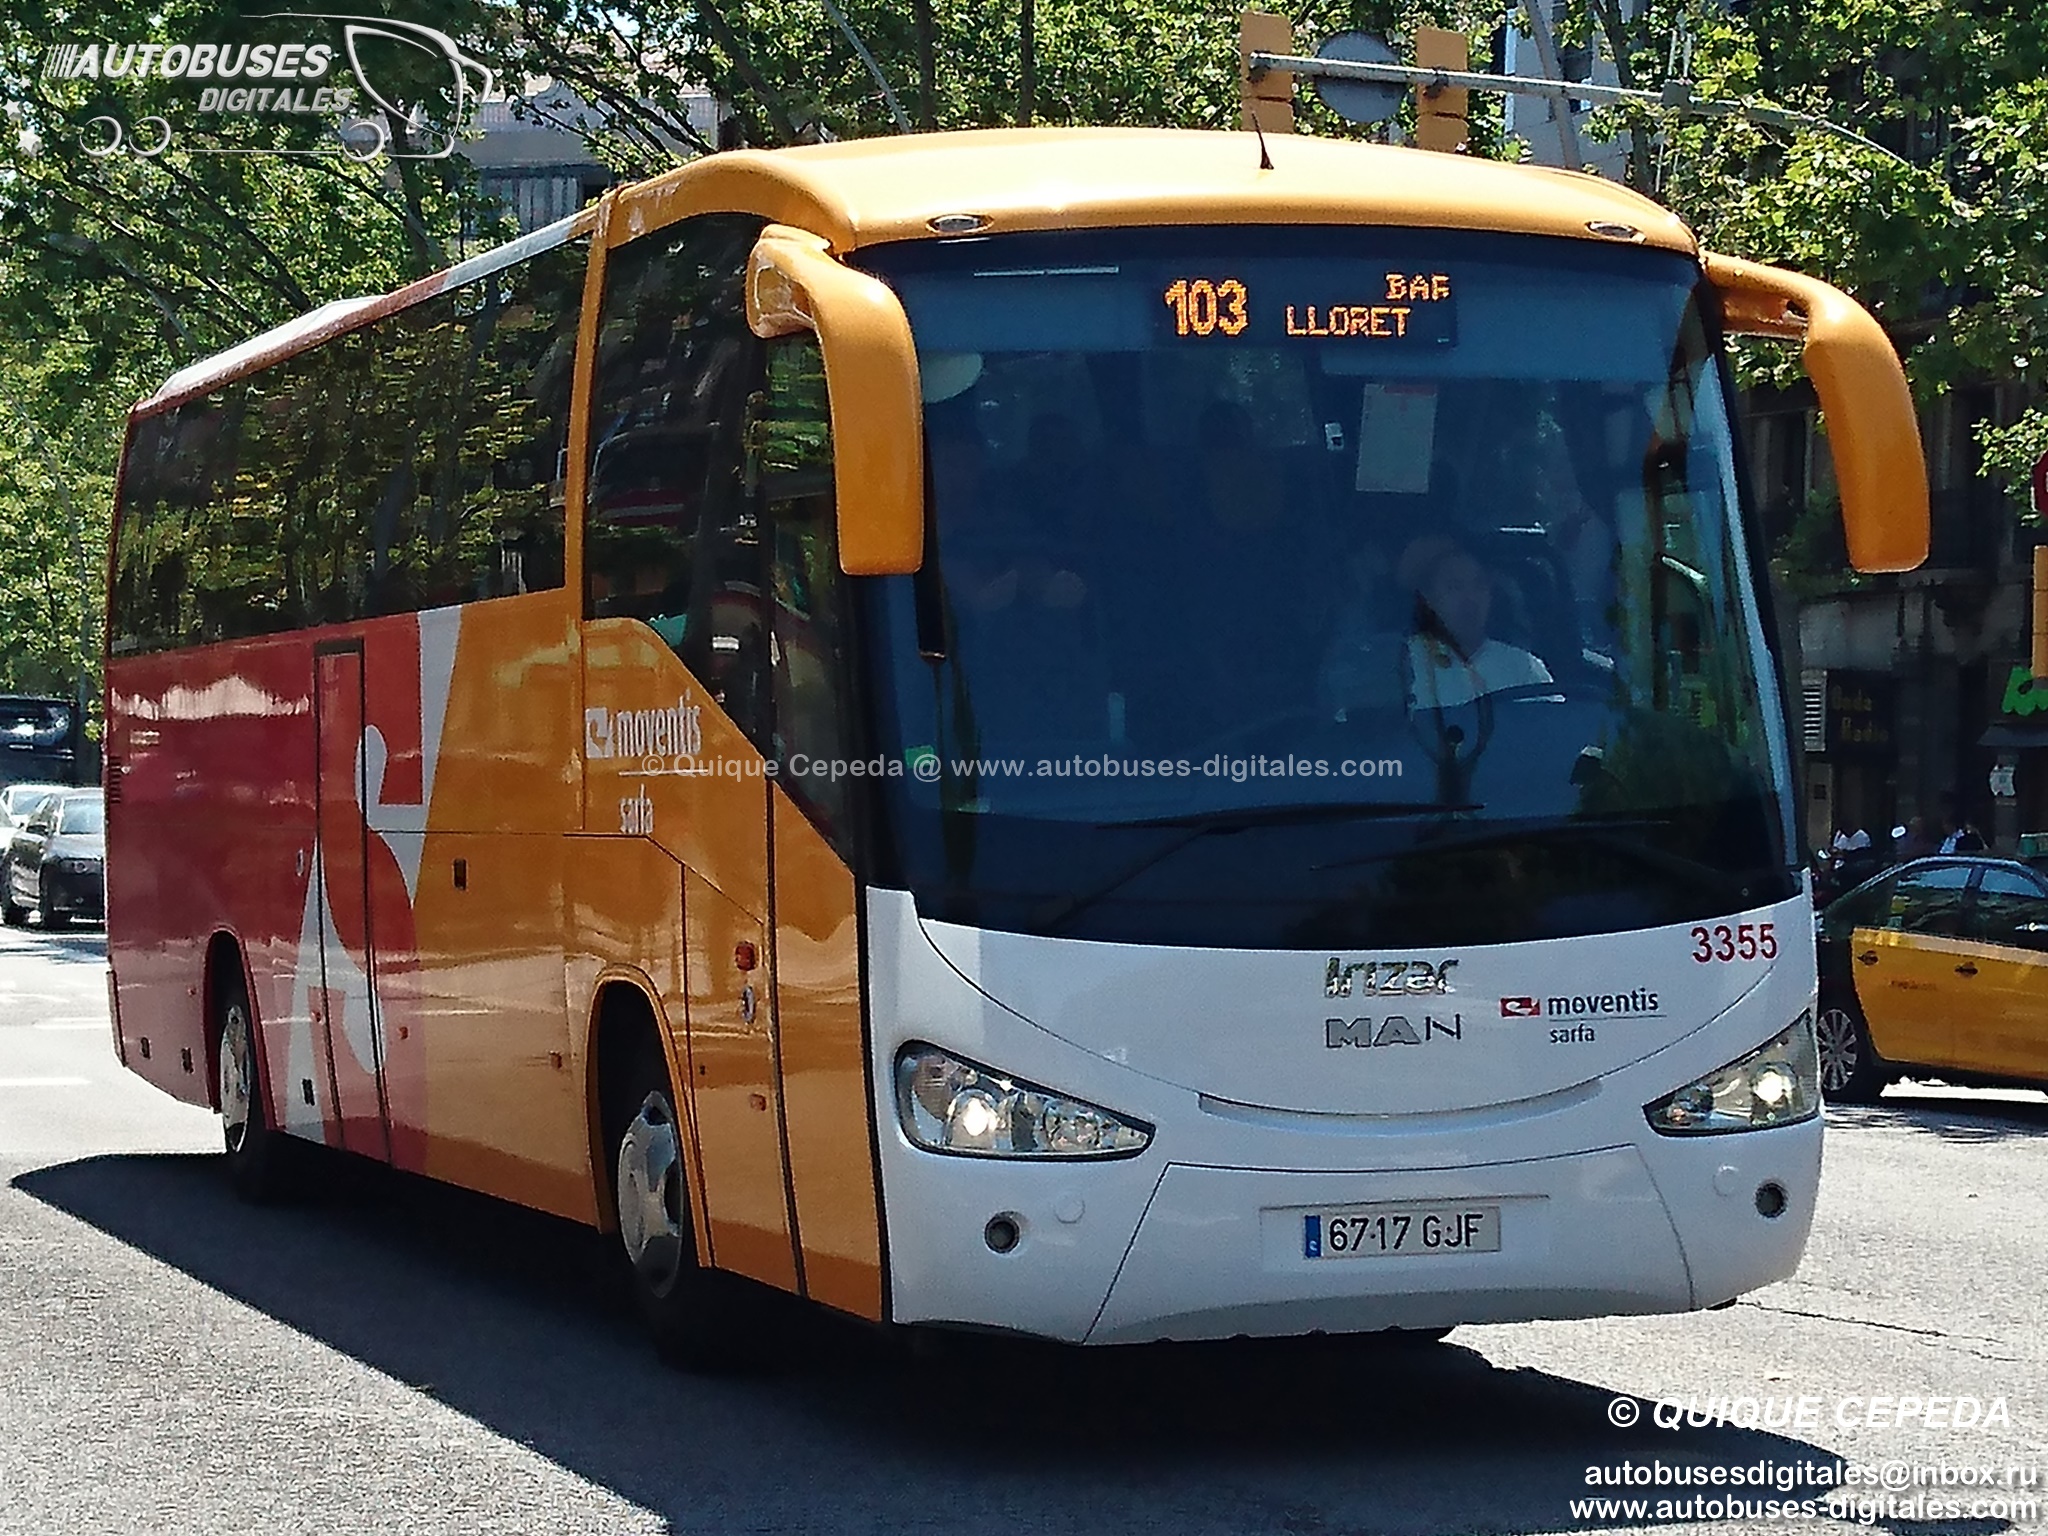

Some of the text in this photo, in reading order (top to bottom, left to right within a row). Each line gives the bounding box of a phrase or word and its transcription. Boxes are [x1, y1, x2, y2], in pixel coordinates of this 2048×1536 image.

[1165, 278, 1249, 337] 103
[1286, 304, 1412, 338] LLORET
[616, 687, 702, 757] moventis
[1691, 923, 1778, 963] 3355
[1547, 986, 1659, 1016] moventis
[1325, 1014, 1461, 1048] MAN
[1549, 1023, 1596, 1044] sarfa
[1329, 1213, 1484, 1252] 6717 GJF
